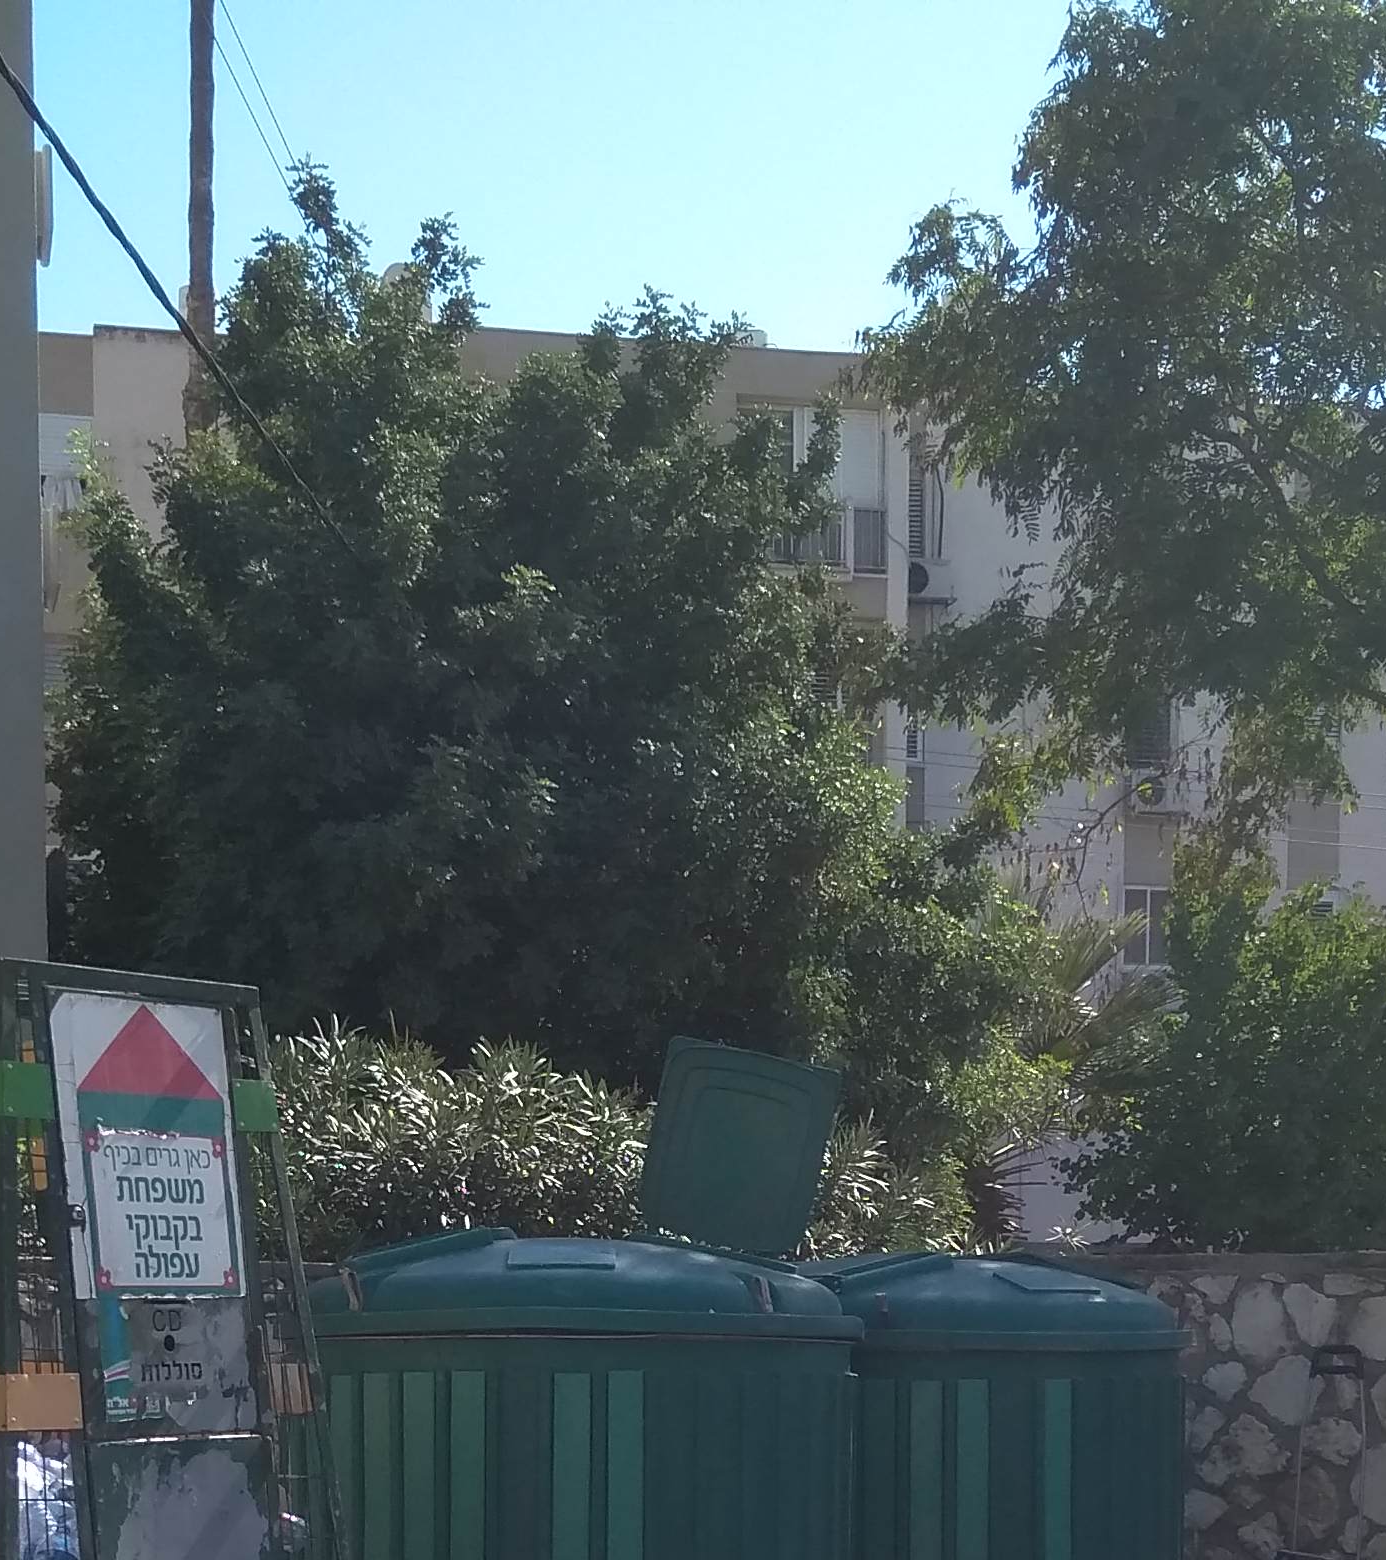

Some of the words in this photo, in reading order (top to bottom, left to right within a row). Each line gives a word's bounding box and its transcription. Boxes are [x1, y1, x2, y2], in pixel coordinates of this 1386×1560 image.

[103, 1145, 142, 1172] בכיף
[146, 1146, 181, 1168] גרים
[183, 1148, 211, 1174] כאן
[116, 1176, 205, 1204] משפחת
[125, 1213, 203, 1250] בקבוקי
[134, 1244, 200, 1278] עפולה
[152, 1309, 182, 1332] CD
[141, 1360, 203, 1382] סוללות
